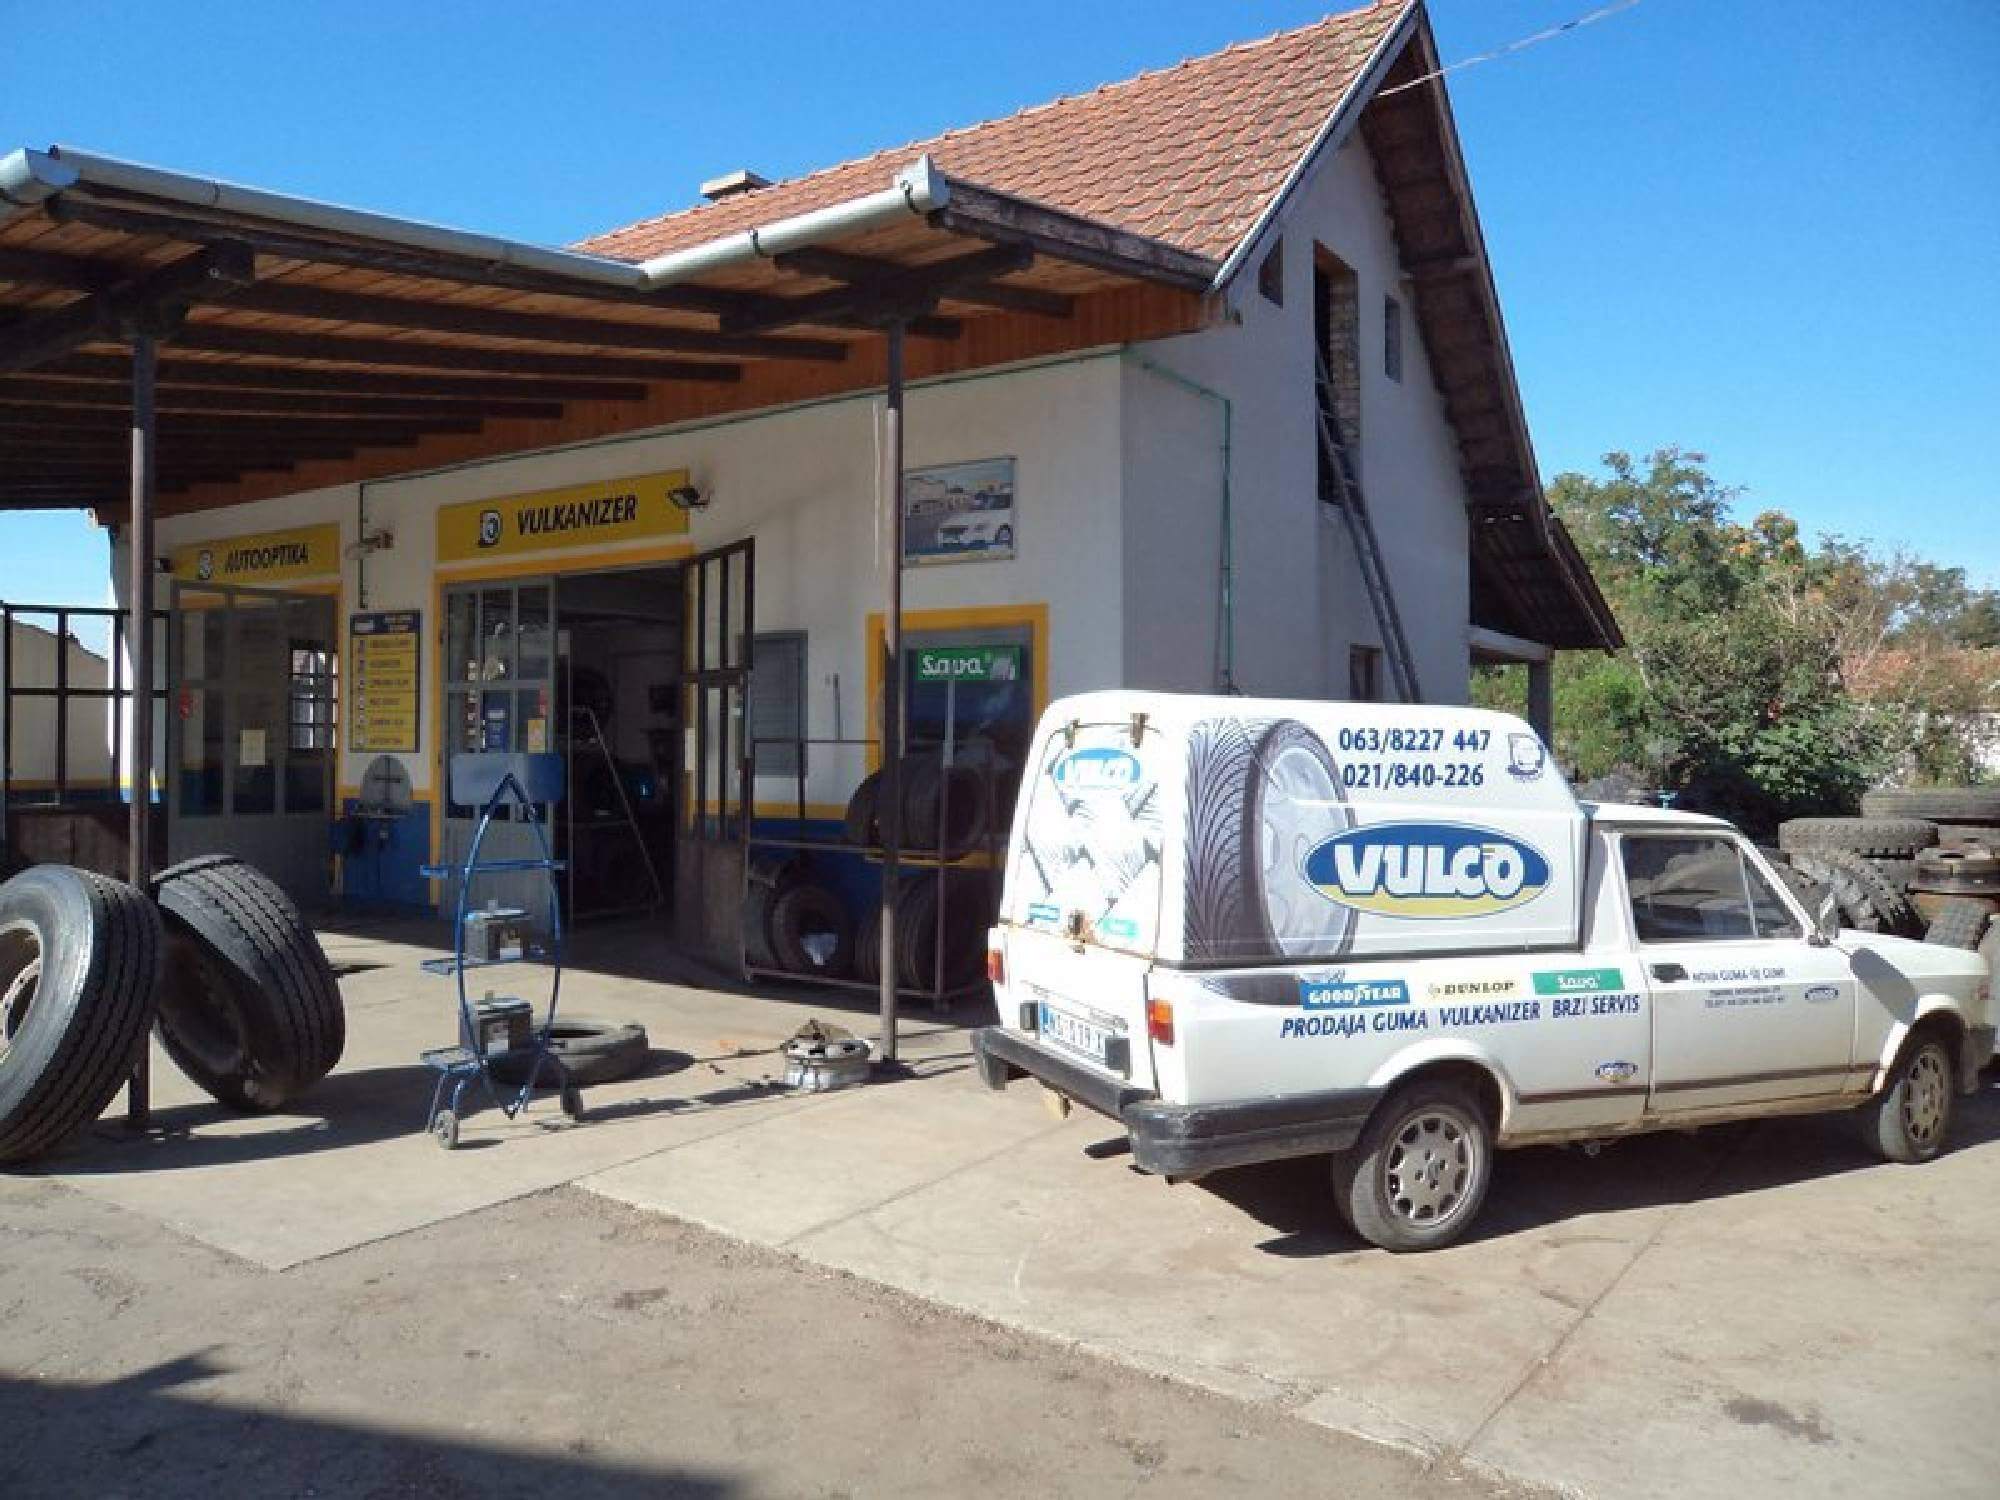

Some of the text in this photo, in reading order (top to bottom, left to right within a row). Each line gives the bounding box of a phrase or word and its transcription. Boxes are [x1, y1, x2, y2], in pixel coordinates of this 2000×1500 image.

[518, 495, 637, 535] VULKANIZER
[1339, 727, 1491, 754] 063/8227 447
[1343, 762, 1484, 790] 021/840-226
[1334, 843, 1524, 898] VULCO
[1444, 981, 1515, 994] DUNLOP
[1280, 1015, 1366, 1038] PRODAJA
[1373, 1010, 1429, 1032] GUMA
[1440, 1001, 1541, 1027] VULKANIZER
[1591, 994, 1641, 1015] SERVIS
